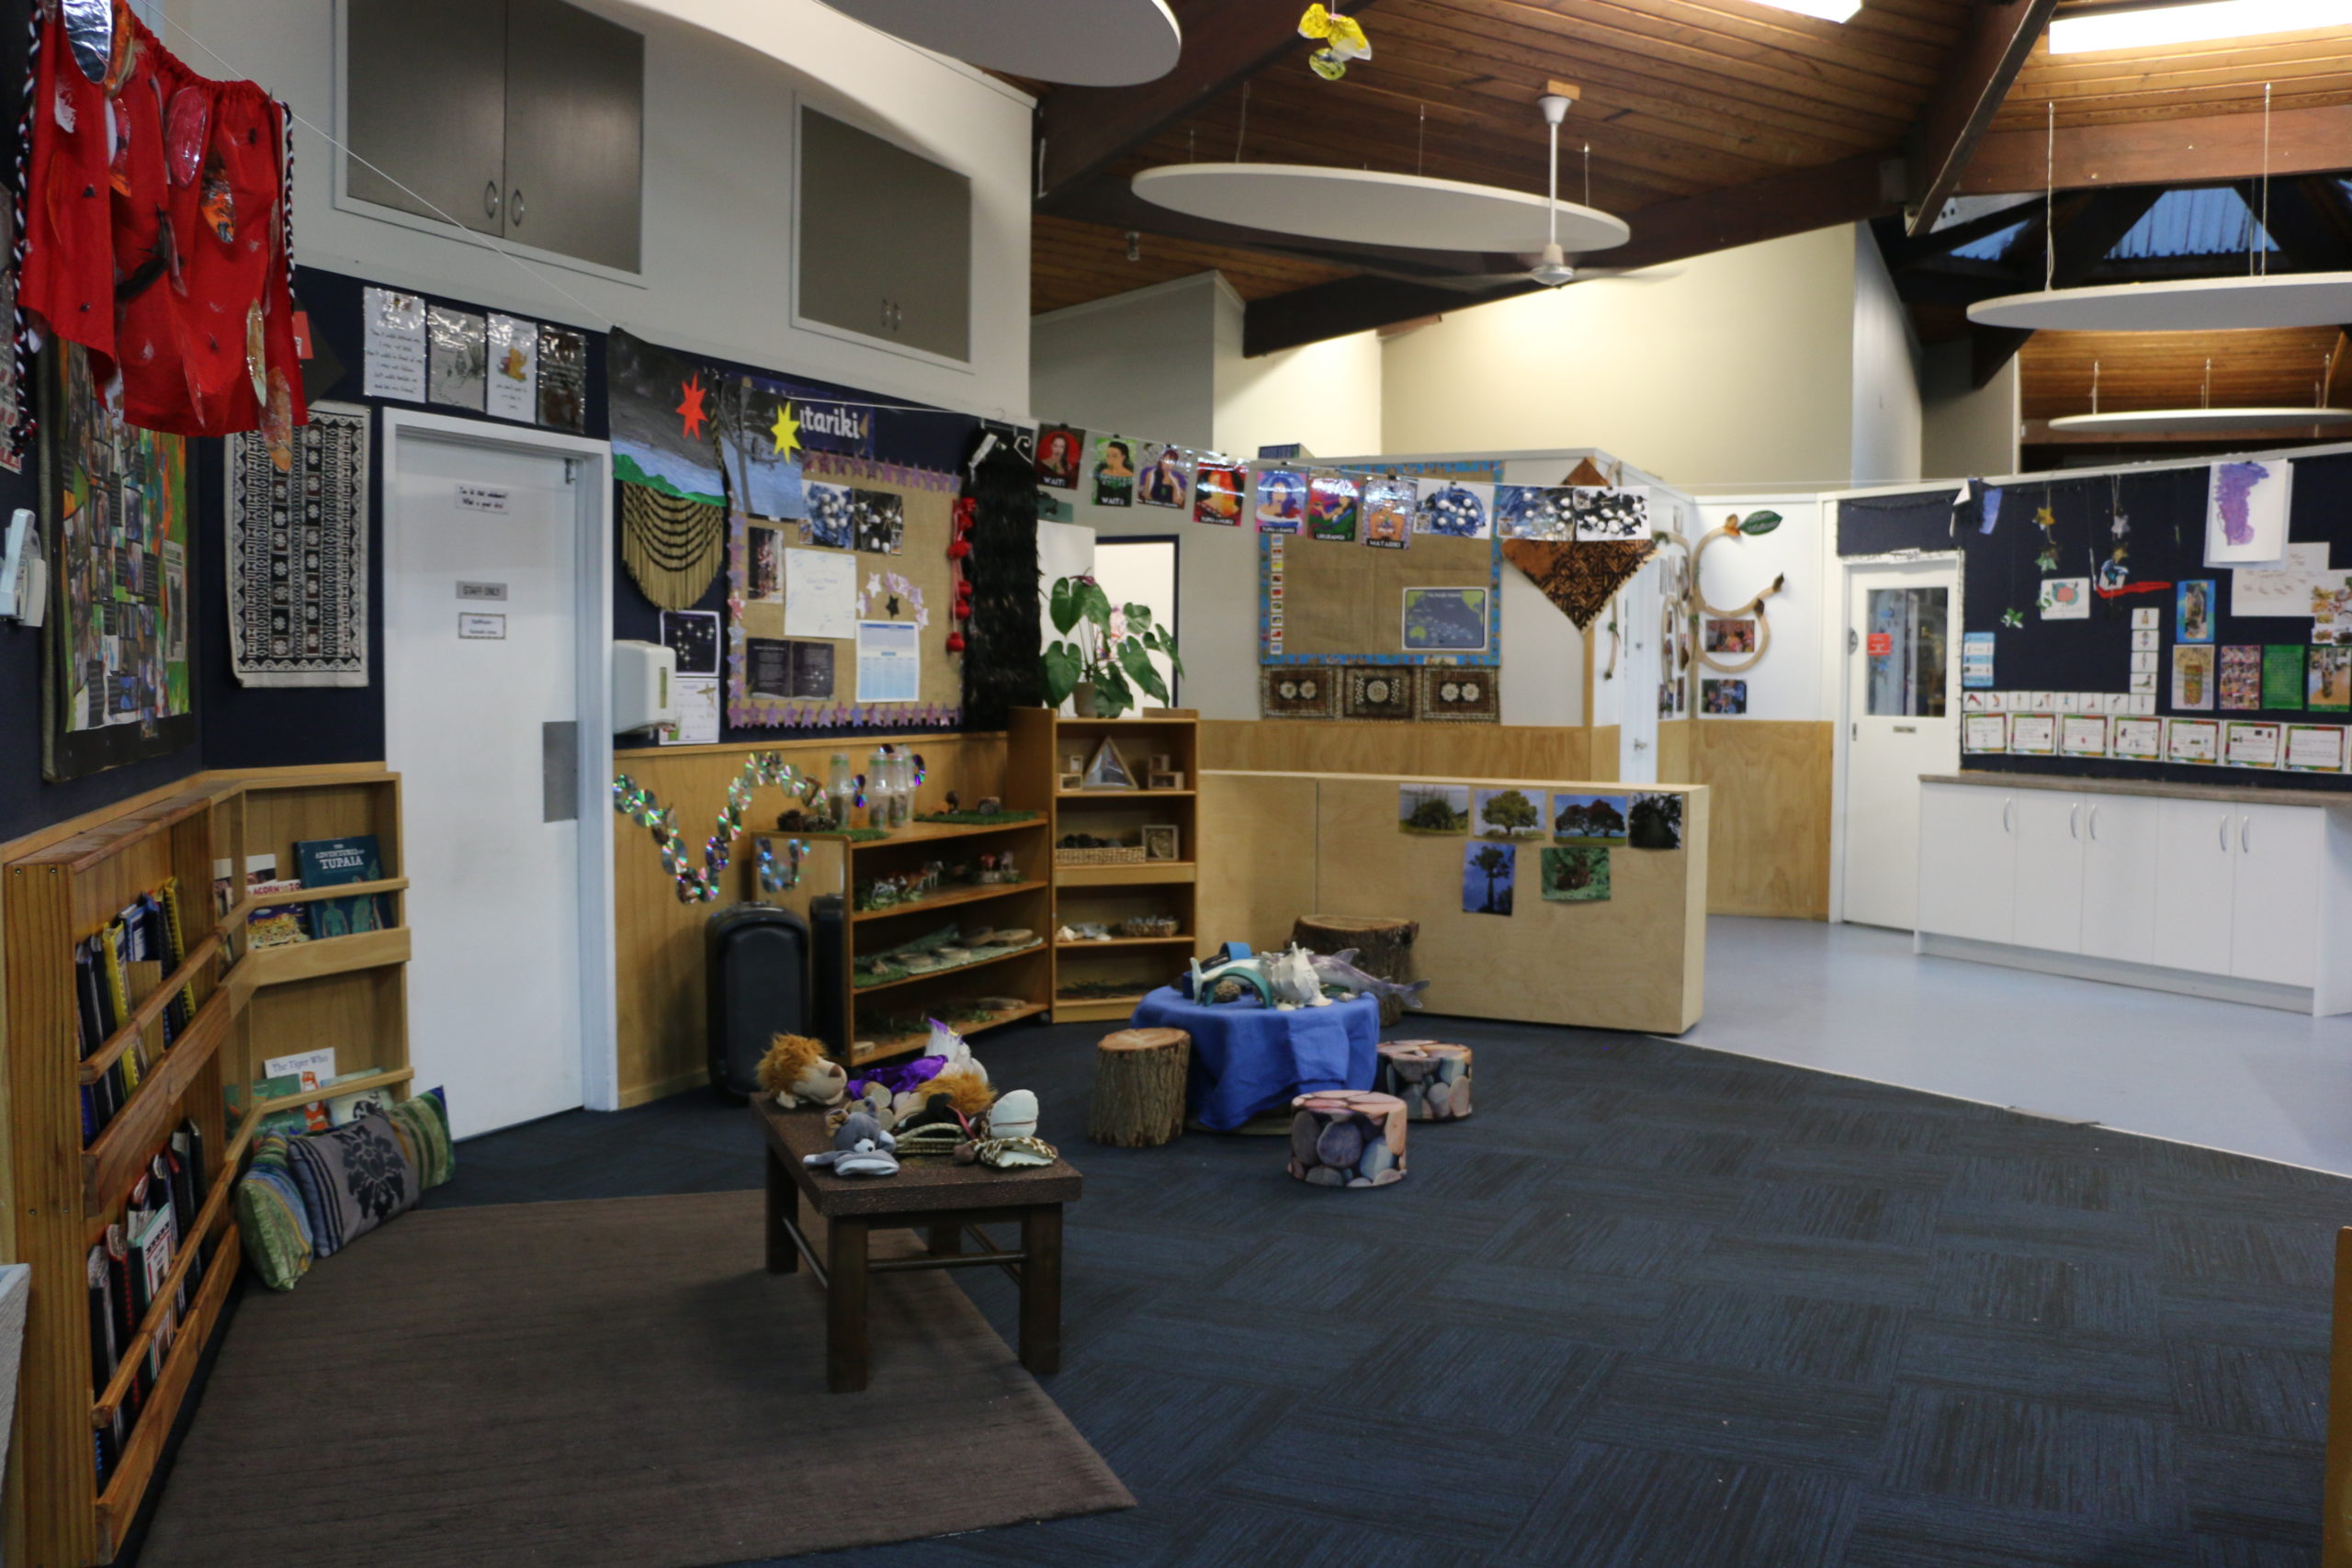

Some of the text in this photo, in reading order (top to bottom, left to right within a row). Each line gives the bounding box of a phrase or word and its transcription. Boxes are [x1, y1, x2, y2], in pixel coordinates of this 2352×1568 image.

[799, 405, 861, 439] tariki
[319, 855, 364, 870] TUPAIA
[254, 886, 279, 895] ACORN
[271, 1055, 328, 1072] The Tiger Who
